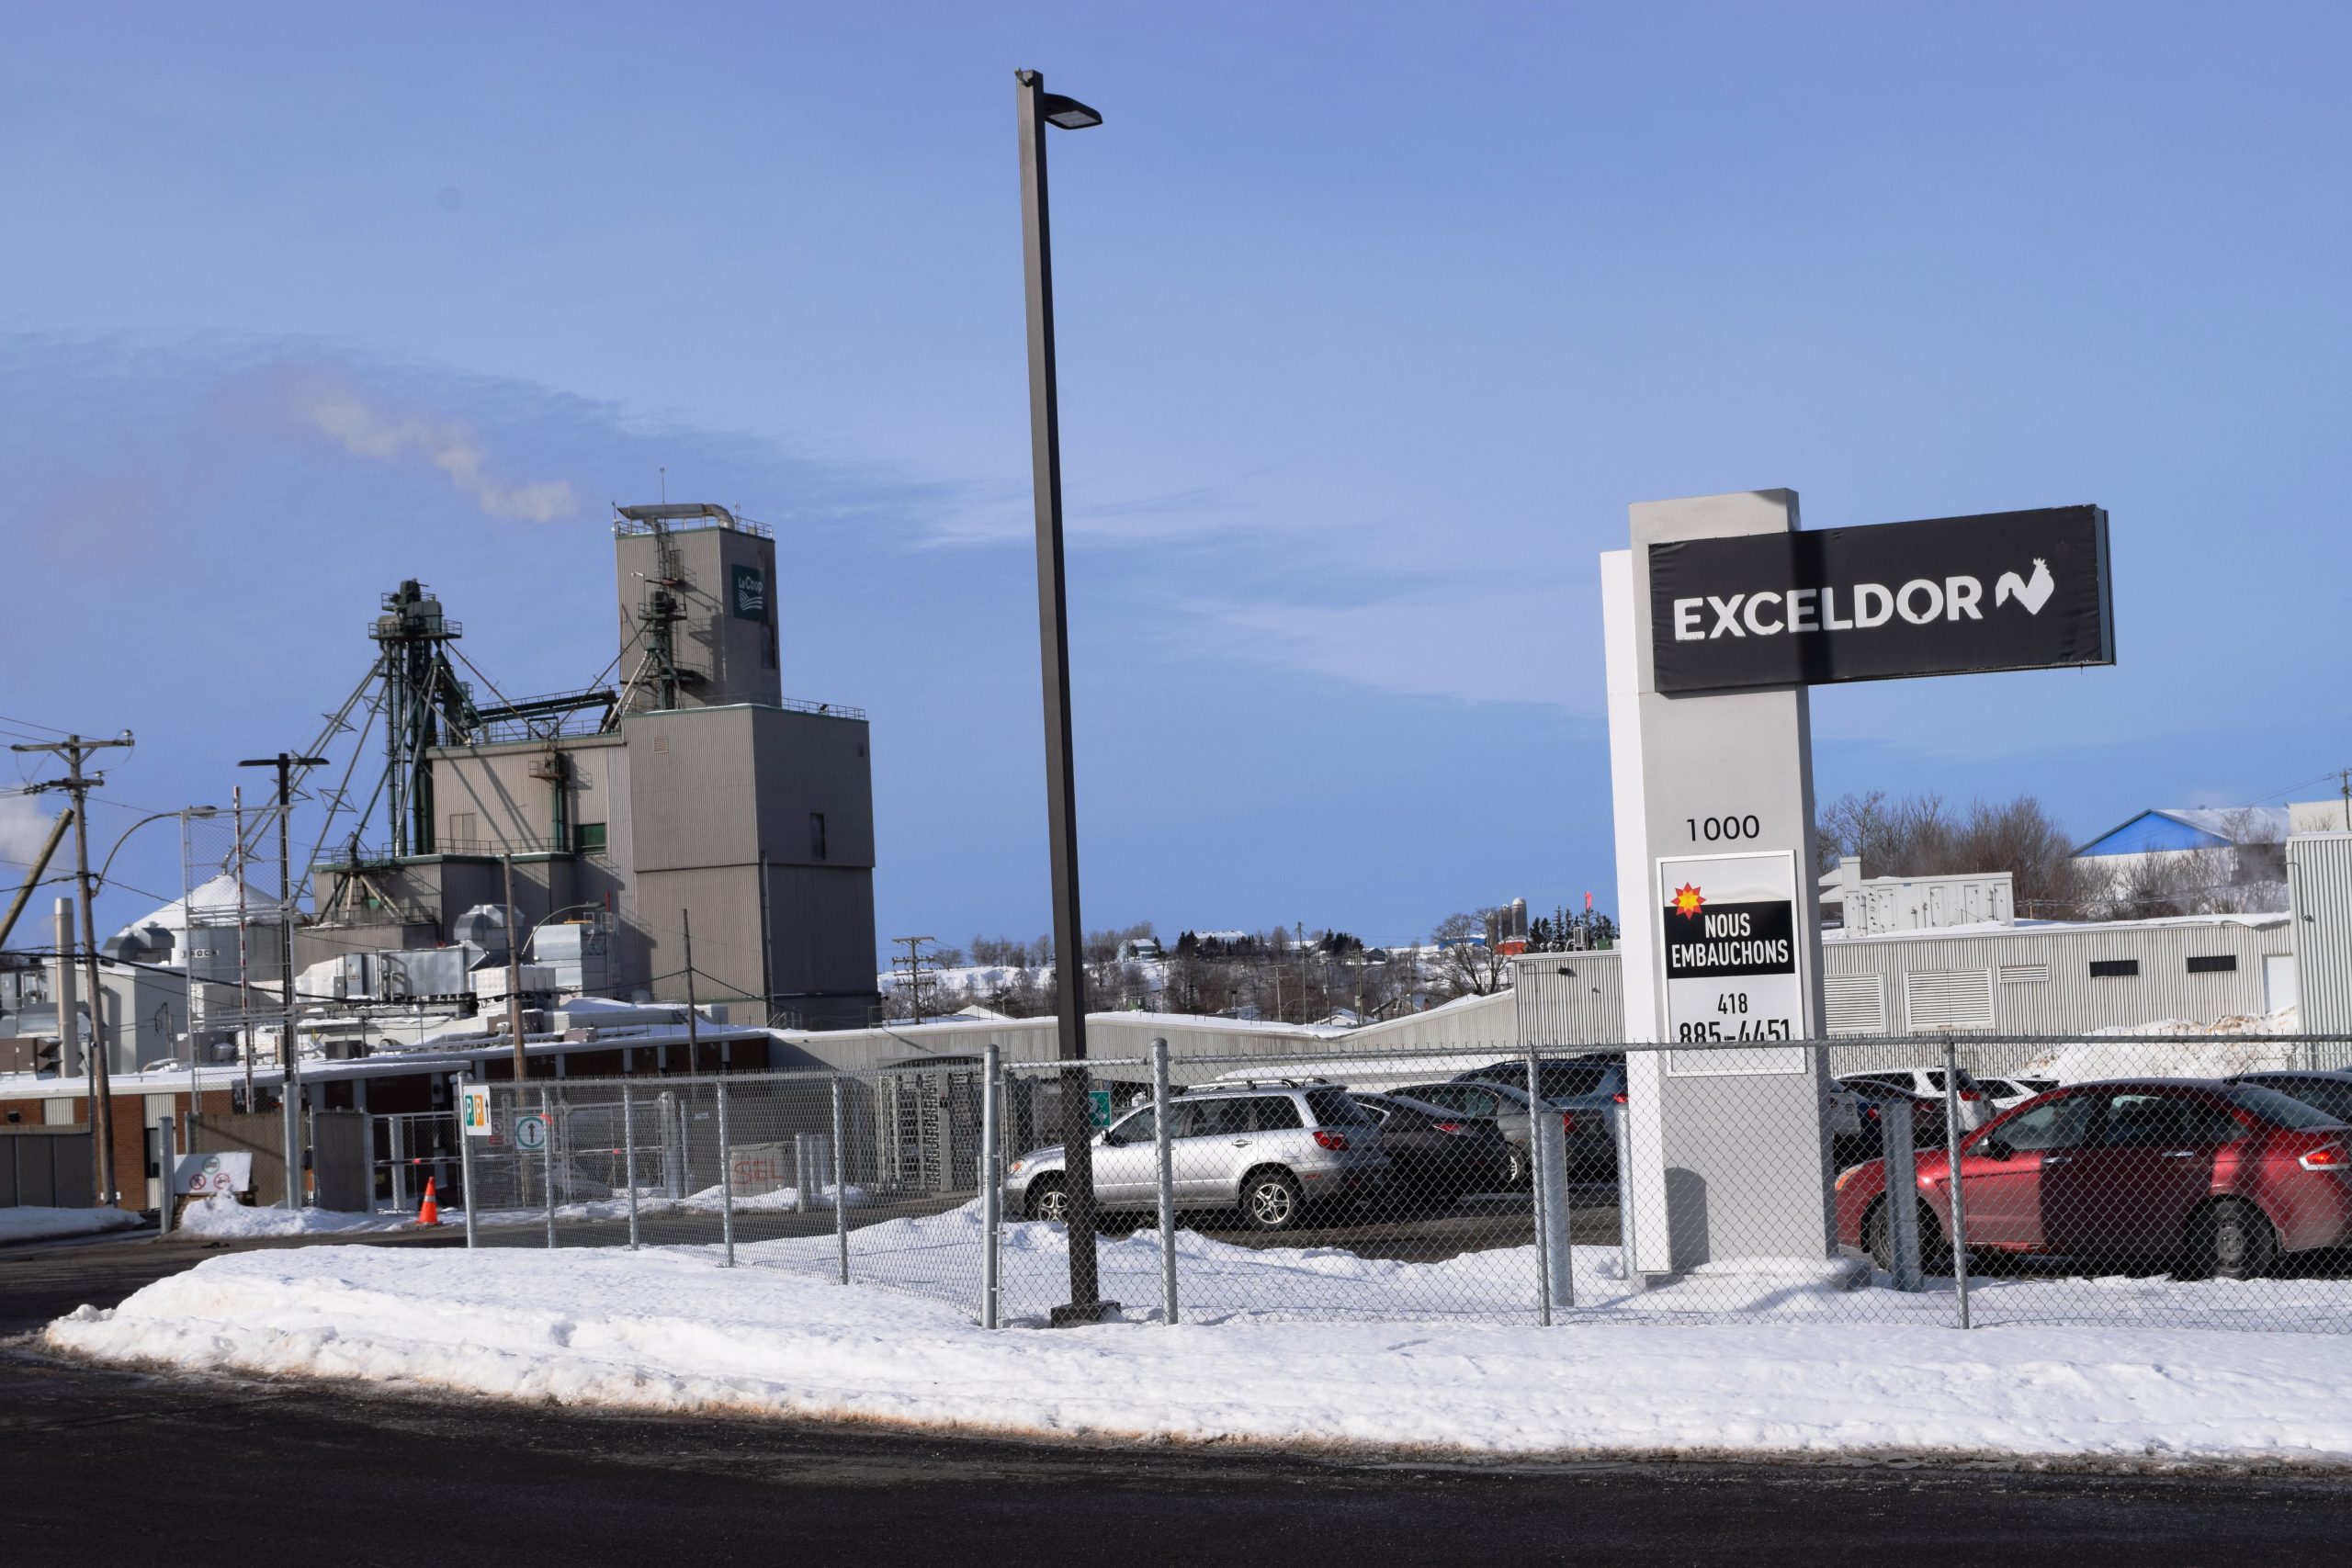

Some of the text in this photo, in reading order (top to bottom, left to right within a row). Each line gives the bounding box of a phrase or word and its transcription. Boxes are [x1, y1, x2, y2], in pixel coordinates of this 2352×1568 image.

[738, 576, 763, 595] La Coop
[1674, 575, 1983, 641] EXCELDOR
[1686, 815, 1759, 841] 1000
[1704, 913, 1750, 938] NOUS
[1671, 940, 1789, 968] EMBAUCHONS
[1717, 992, 1748, 1014] 418
